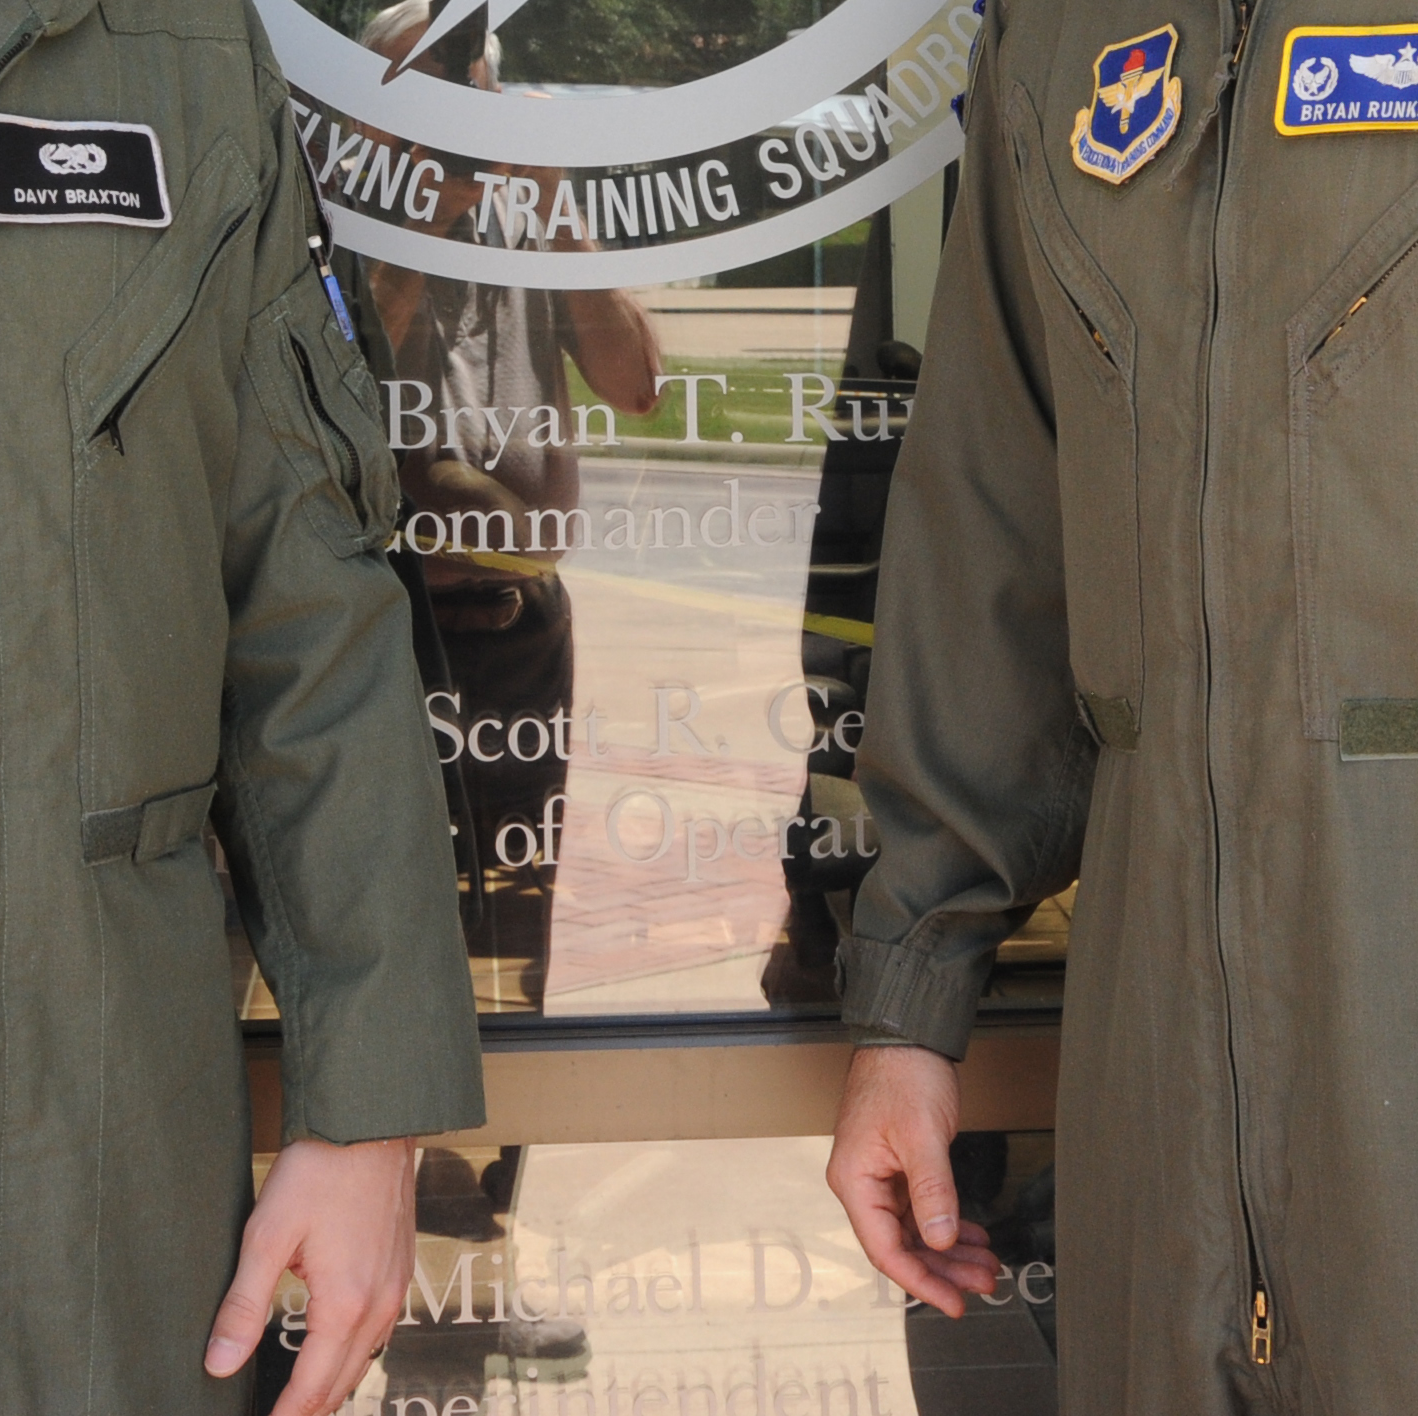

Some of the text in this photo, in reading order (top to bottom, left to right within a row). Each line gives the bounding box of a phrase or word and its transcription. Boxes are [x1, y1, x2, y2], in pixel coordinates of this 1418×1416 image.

[1300, 101, 1360, 121] BRYAN
[14, 188, 140, 208] DAVY BRAXTON
[473, 158, 740, 240] TRAINING
[381, 379, 622, 471] Bryan
[655, 374, 744, 444] T.
[384, 478, 822, 554] ommander
[424, 691, 608, 763] Scott
[651, 686, 731, 758] R.
[495, 793, 572, 867] of
[397, 1242, 703, 1325] Michael
[746, 1241, 830, 1313] D.
